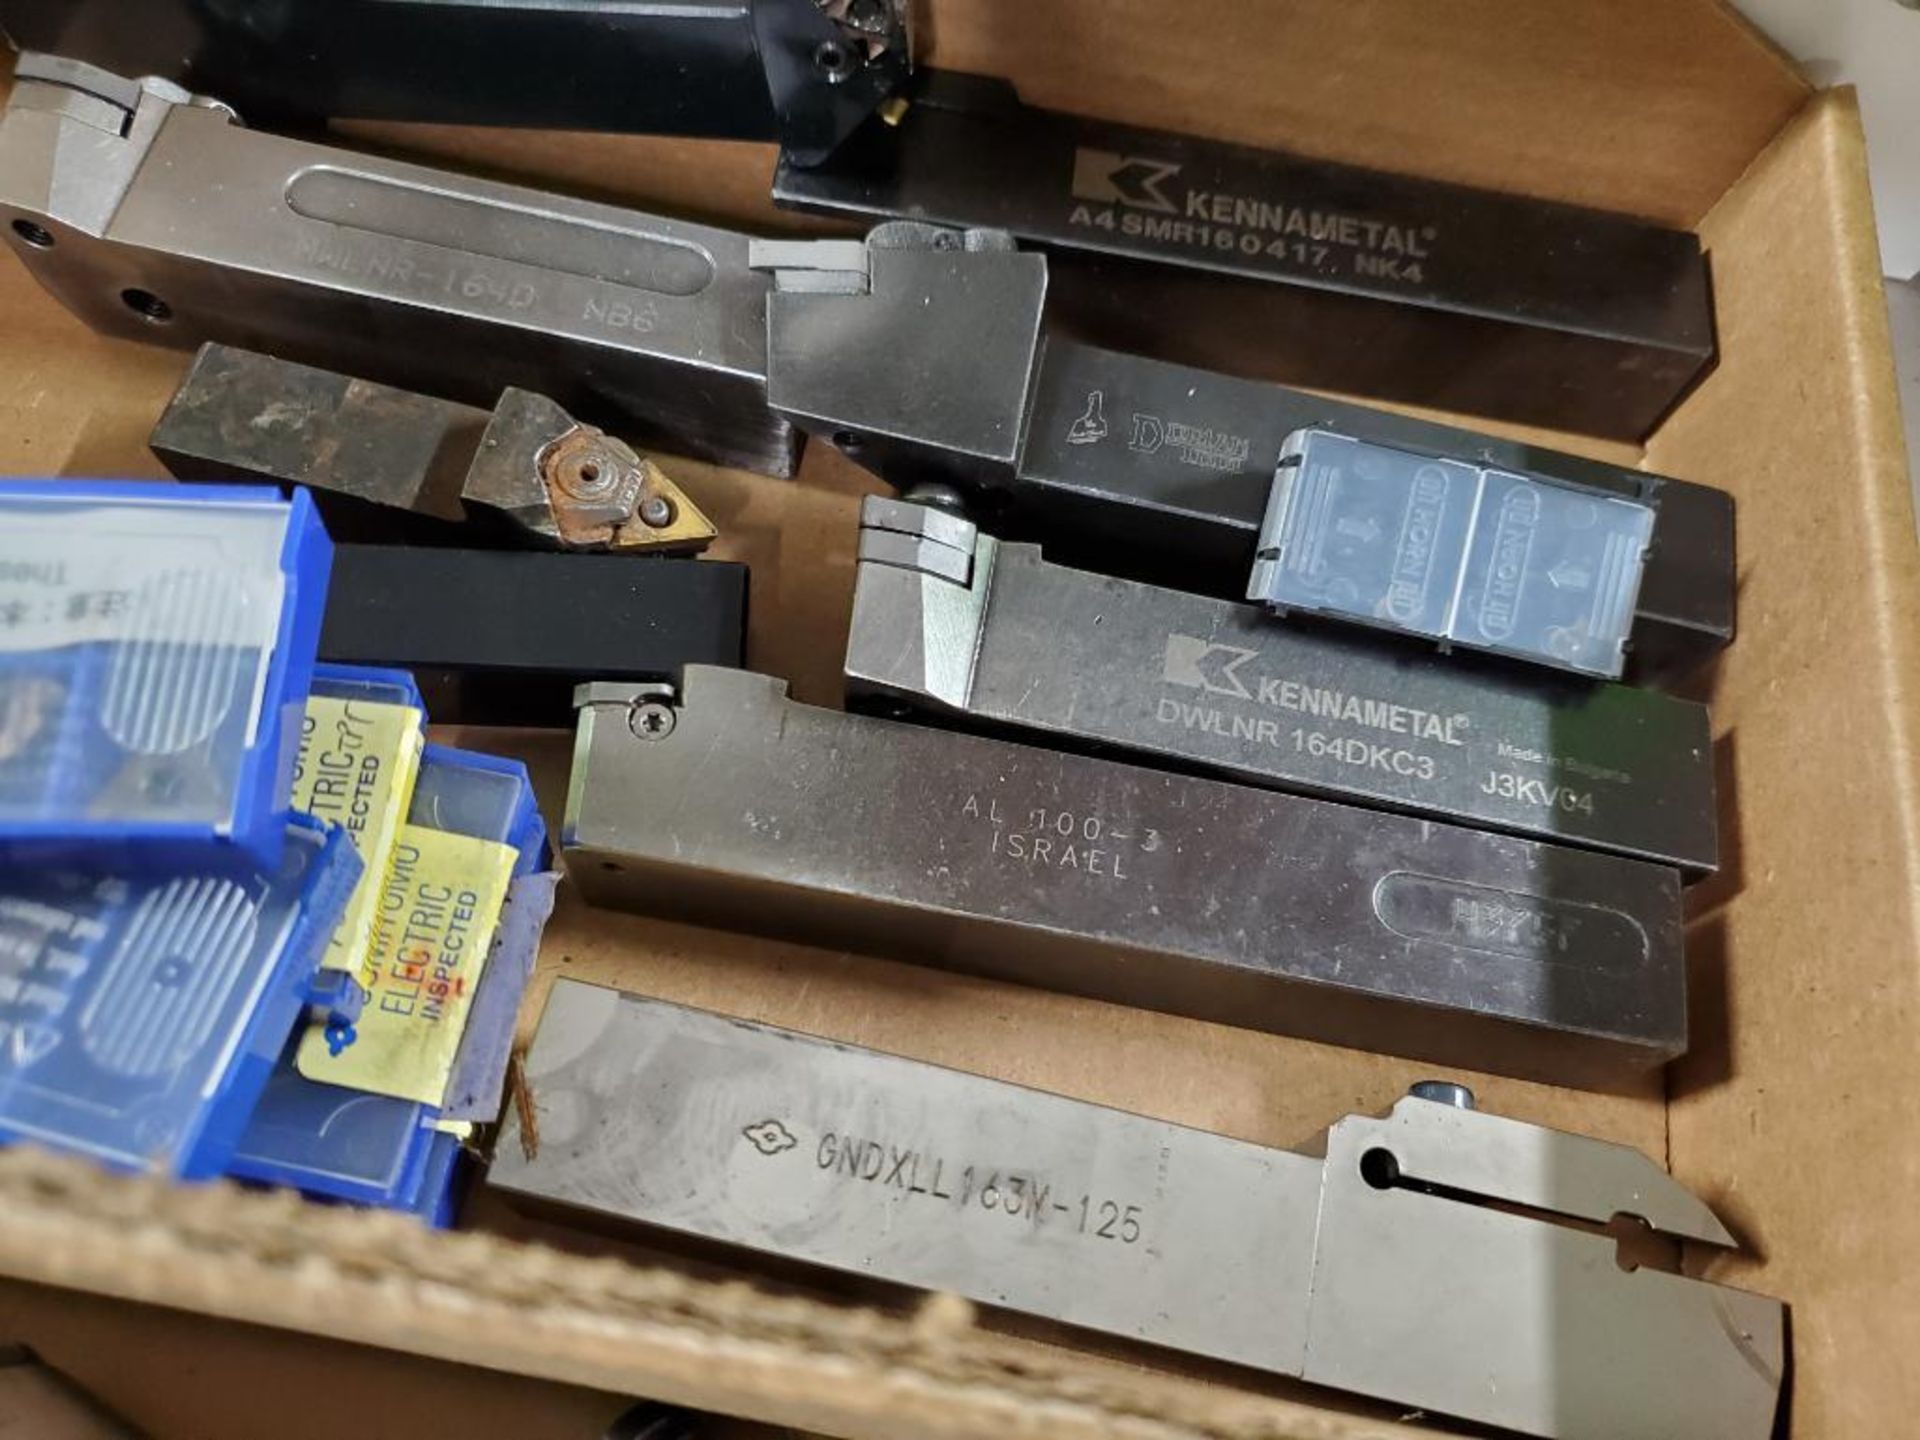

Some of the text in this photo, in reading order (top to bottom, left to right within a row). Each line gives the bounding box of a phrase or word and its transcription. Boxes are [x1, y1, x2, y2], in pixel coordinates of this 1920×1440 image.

[1354, 253, 1425, 284] NK4
[1155, 697, 1436, 780] DWLNR 164DKC3
[1497, 742, 1544, 764] Made
[961, 794, 1003, 824] AL
[1480, 771, 1595, 816] J3KV04
[991, 830, 1127, 880] ISRAEL
[380, 883, 452, 1016] ELECTRIC
[420, 889, 478, 1022] INSPECTED
